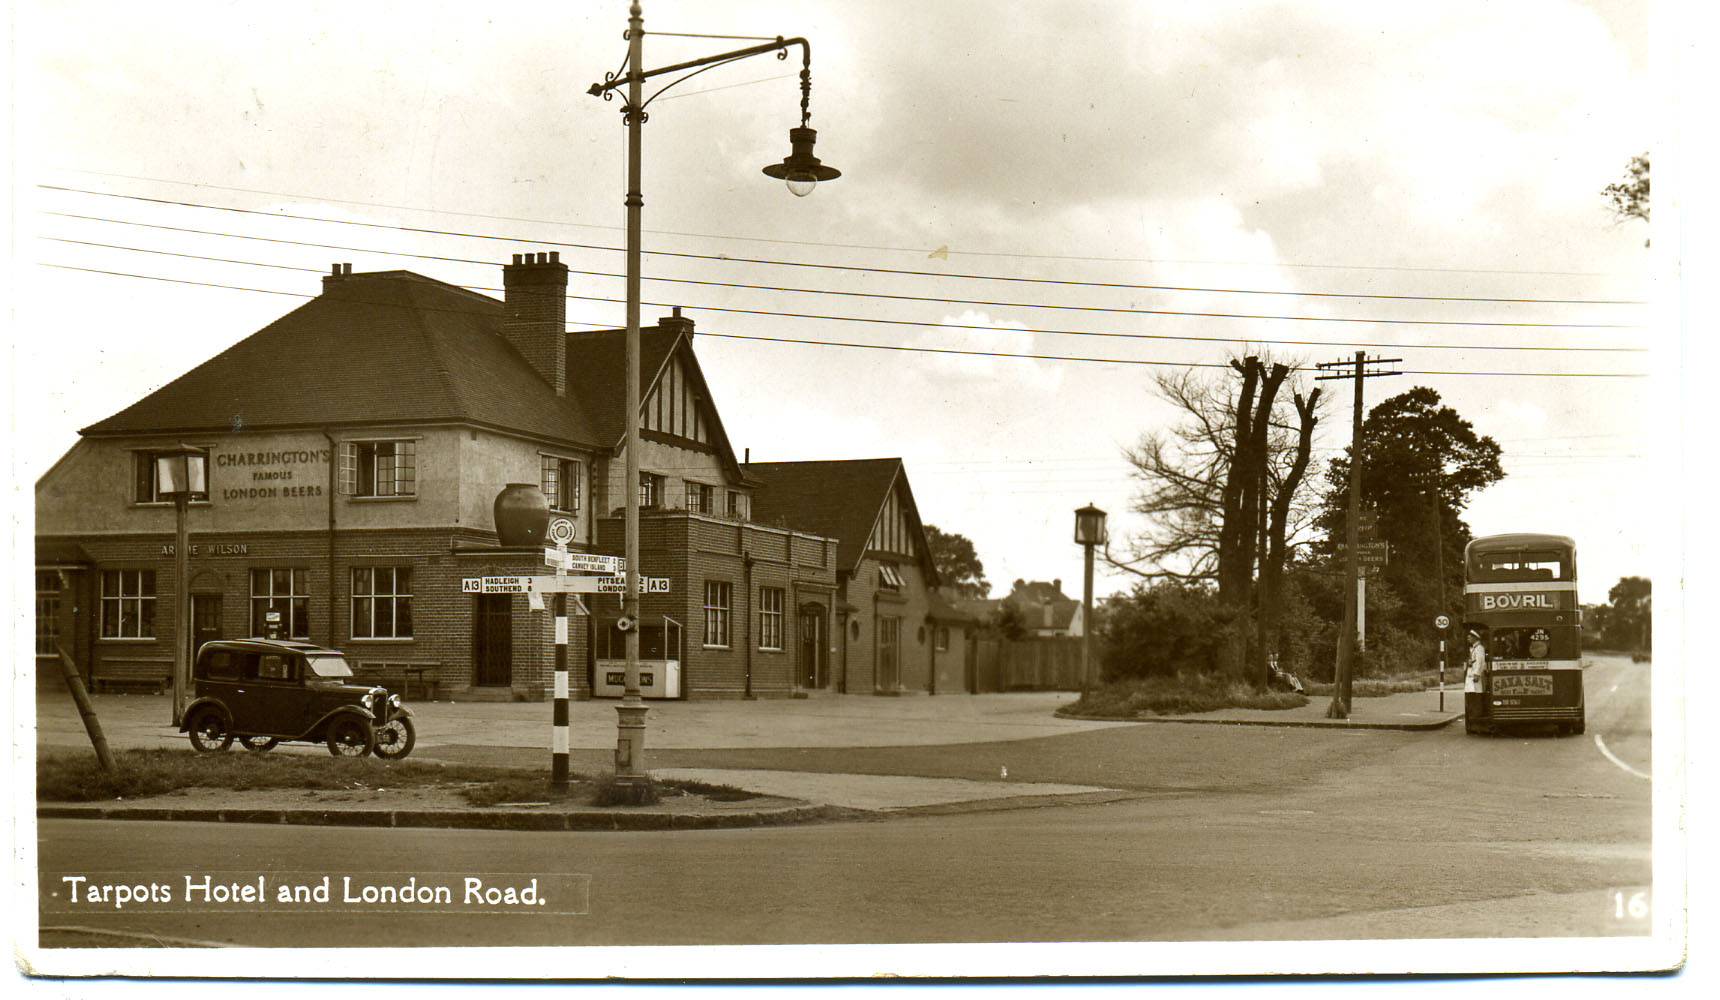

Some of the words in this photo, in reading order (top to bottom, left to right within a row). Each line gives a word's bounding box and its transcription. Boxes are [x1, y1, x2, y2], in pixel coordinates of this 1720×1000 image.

[217, 449, 330, 467] CHARRINGTON'S
[252, 471, 292, 481] FAMOUS
[223, 487, 277, 500] LONDON
[283, 485, 322, 498] BEERS
[161, 545, 198, 555] ARIE
[208, 544, 247, 554] WILSON
[572, 554, 587, 562] SOUTH
[588, 555, 610, 564] BENFLEET
[572, 562, 589, 570] CANVEY
[464, 580, 480, 591] A13
[485, 577, 519, 585] HADLEIGH
[527, 577, 532, 585] 3
[597, 577, 626, 585] PITSEA
[650, 580, 668, 591] A13
[485, 585, 522, 593] SOUTHEND
[597, 585, 627, 593] LONDON
[1484, 595, 1553, 610] BOVRIL
[1524, 677, 1553, 691] SALT
